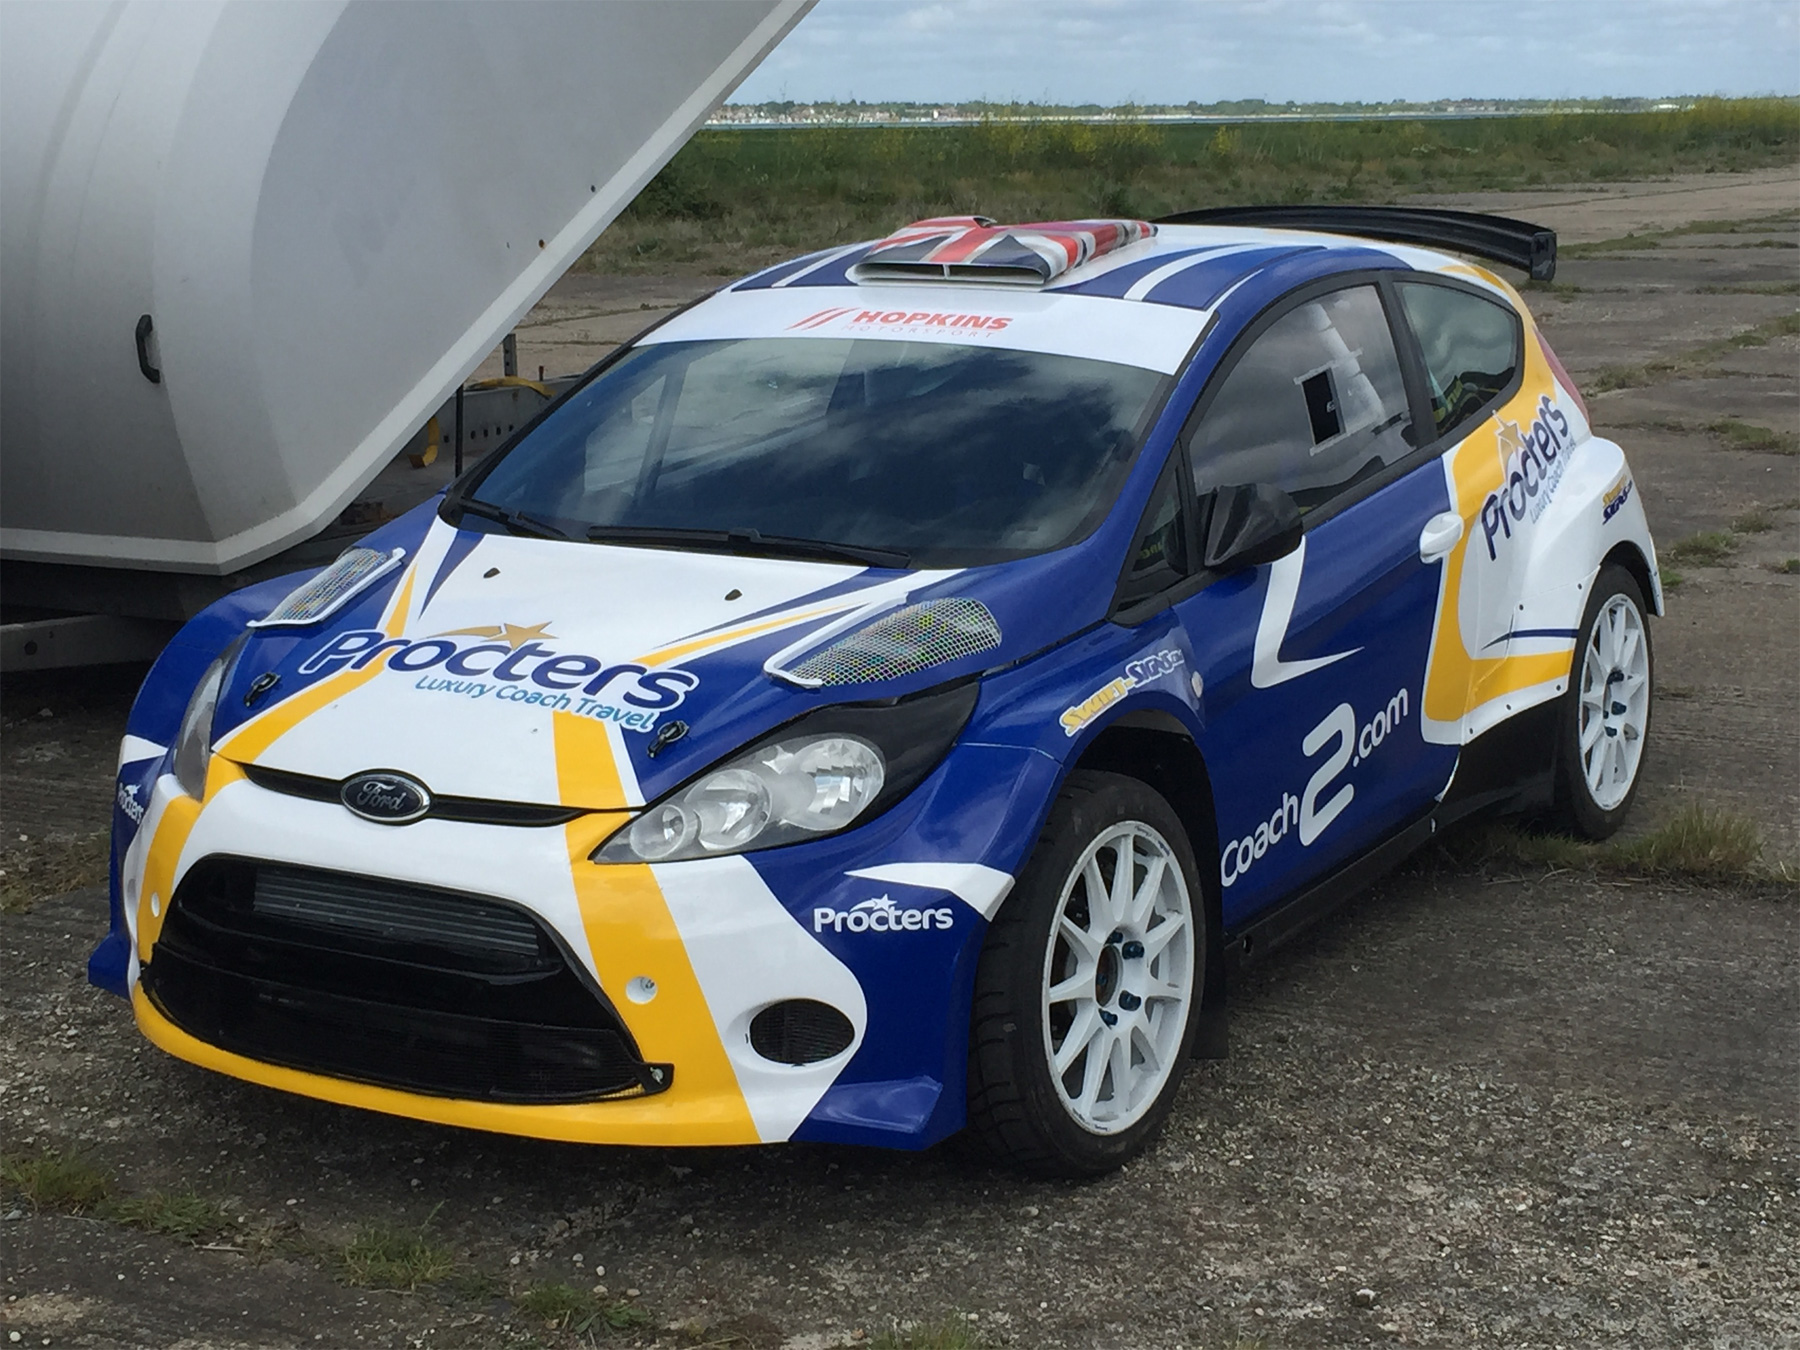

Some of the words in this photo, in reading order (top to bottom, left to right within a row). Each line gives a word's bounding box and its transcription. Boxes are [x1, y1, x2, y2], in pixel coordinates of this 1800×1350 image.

[841, 324, 996, 339] MOTORSPORT
[853, 310, 1013, 330] HOPKINS
[1481, 395, 1568, 561] Procters
[301, 630, 696, 709] Procters
[414, 674, 497, 699] Luxury
[496, 684, 571, 710] Coach
[574, 697, 655, 729] Travel
[356, 781, 407, 811] Ford
[814, 906, 954, 933] Procters
